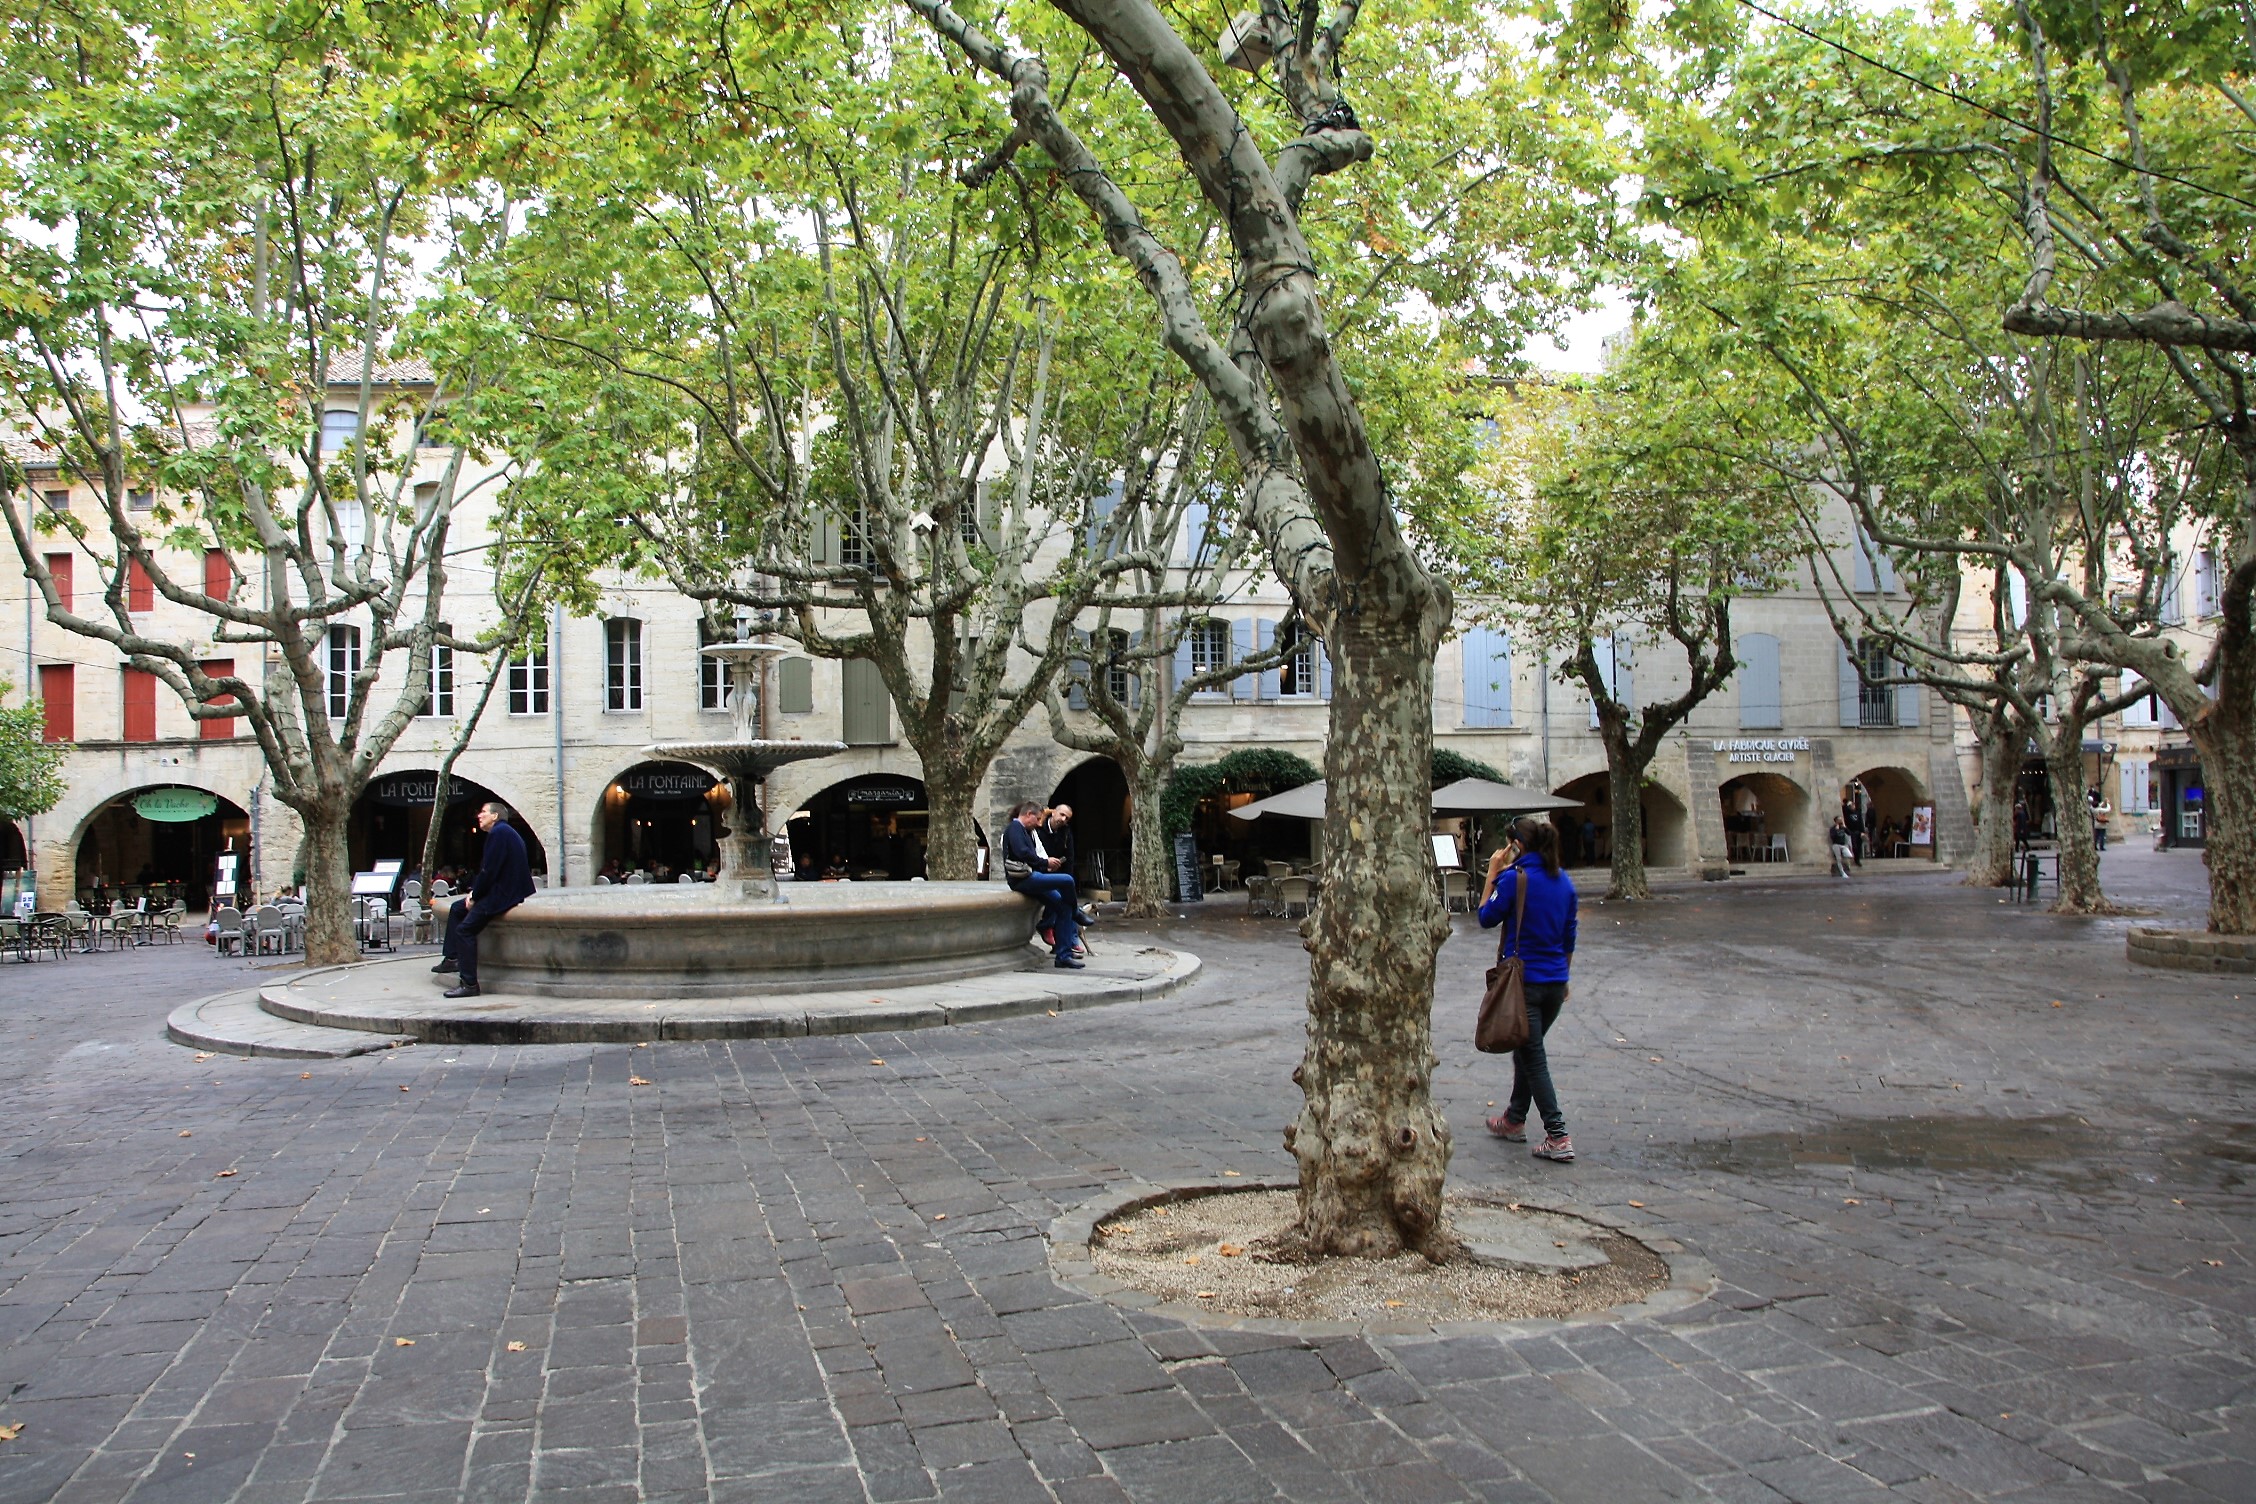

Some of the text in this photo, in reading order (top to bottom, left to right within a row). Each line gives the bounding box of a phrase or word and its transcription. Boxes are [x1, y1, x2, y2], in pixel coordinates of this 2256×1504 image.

[1713, 736, 1809, 751] LA FABRIQUE GIVRÉE
[1729, 752, 1794, 763] ARTISTE GLACIER
[380, 781, 464, 797] LA FONTNE
[629, 775, 707, 789] LA FONTAINE
